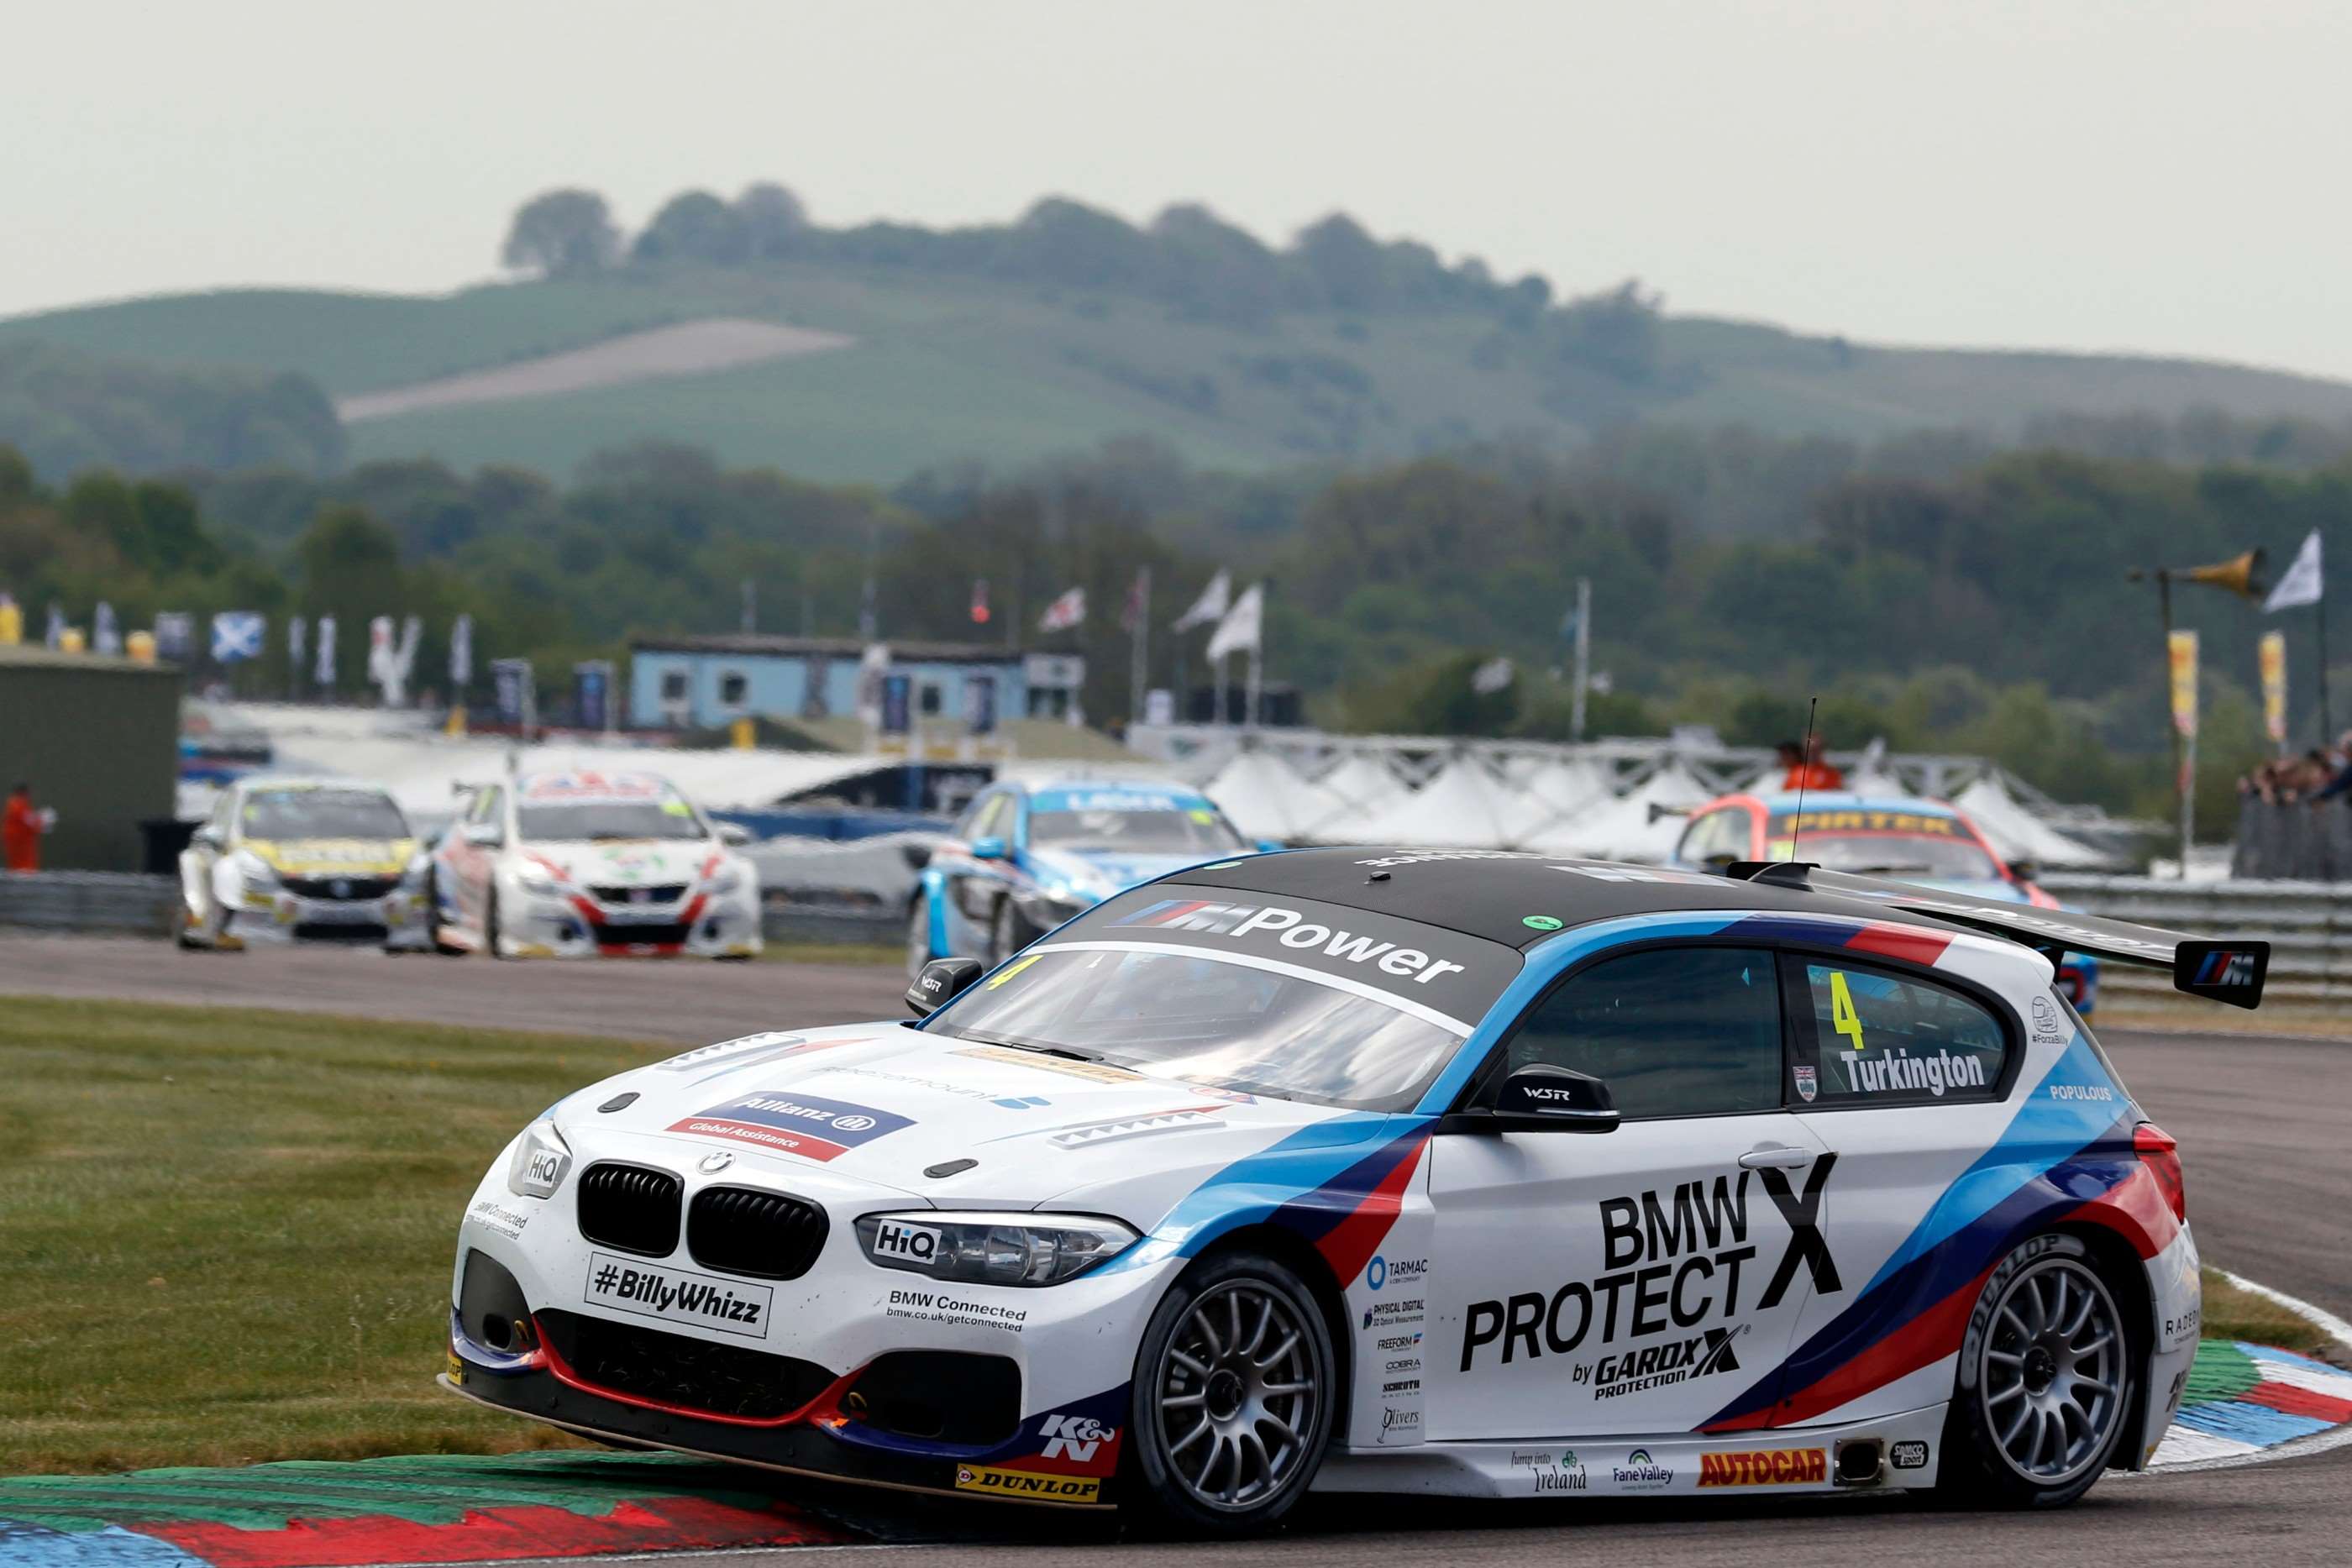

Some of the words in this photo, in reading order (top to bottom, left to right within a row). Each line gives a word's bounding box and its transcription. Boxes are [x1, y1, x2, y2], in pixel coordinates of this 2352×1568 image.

[1785, 811, 1951, 834] PIRTEK
[921, 975, 942, 993] WSR
[1830, 972, 1864, 1050] 4
[1841, 1048, 1985, 1096] Turkington
[1522, 1086, 1571, 1101] WSR
[2050, 1085, 2113, 1102] POPULOUS
[734, 1098, 835, 1121] Allianz
[689, 1121, 732, 1135] Global
[732, 1127, 800, 1148] Assistance
[528, 1153, 558, 1183] HiQ
[1599, 1170, 1750, 1271] BMW
[1756, 1151, 1843, 1310] X
[878, 1225, 935, 1260] HiQ
[1389, 1259, 1428, 1277] TARMAC
[594, 1264, 761, 1324] #BillyWhizz
[1971, 1235, 2061, 1337] DUNLOP
[890, 1290, 934, 1308] BMW
[937, 1296, 1027, 1321] Connected
[1373, 1302, 1400, 1315] PHYSICAL
[1402, 1299, 1424, 1312] DIGITAL
[1460, 1246, 1756, 1372] PROTECT
[886, 1307, 1022, 1333] bmw.co.uk/getconnected
[2166, 1308, 2199, 1335] RADEO
[1378, 1337, 1412, 1350] FREEFORM
[1386, 1359, 1420, 1369] COBRA
[1572, 1364, 1593, 1385] by
[1595, 1370, 1687, 1401] PROTECTION
[1383, 1407, 1419, 1428] Olivers
[1535, 1453, 1551, 1465] into
[1894, 1445, 1924, 1455] SAMCO
[1533, 1465, 1587, 1492] Ireland
[1699, 1450, 1825, 1487] AUTOCAR
[979, 1473, 1099, 1496] DUNLOP
